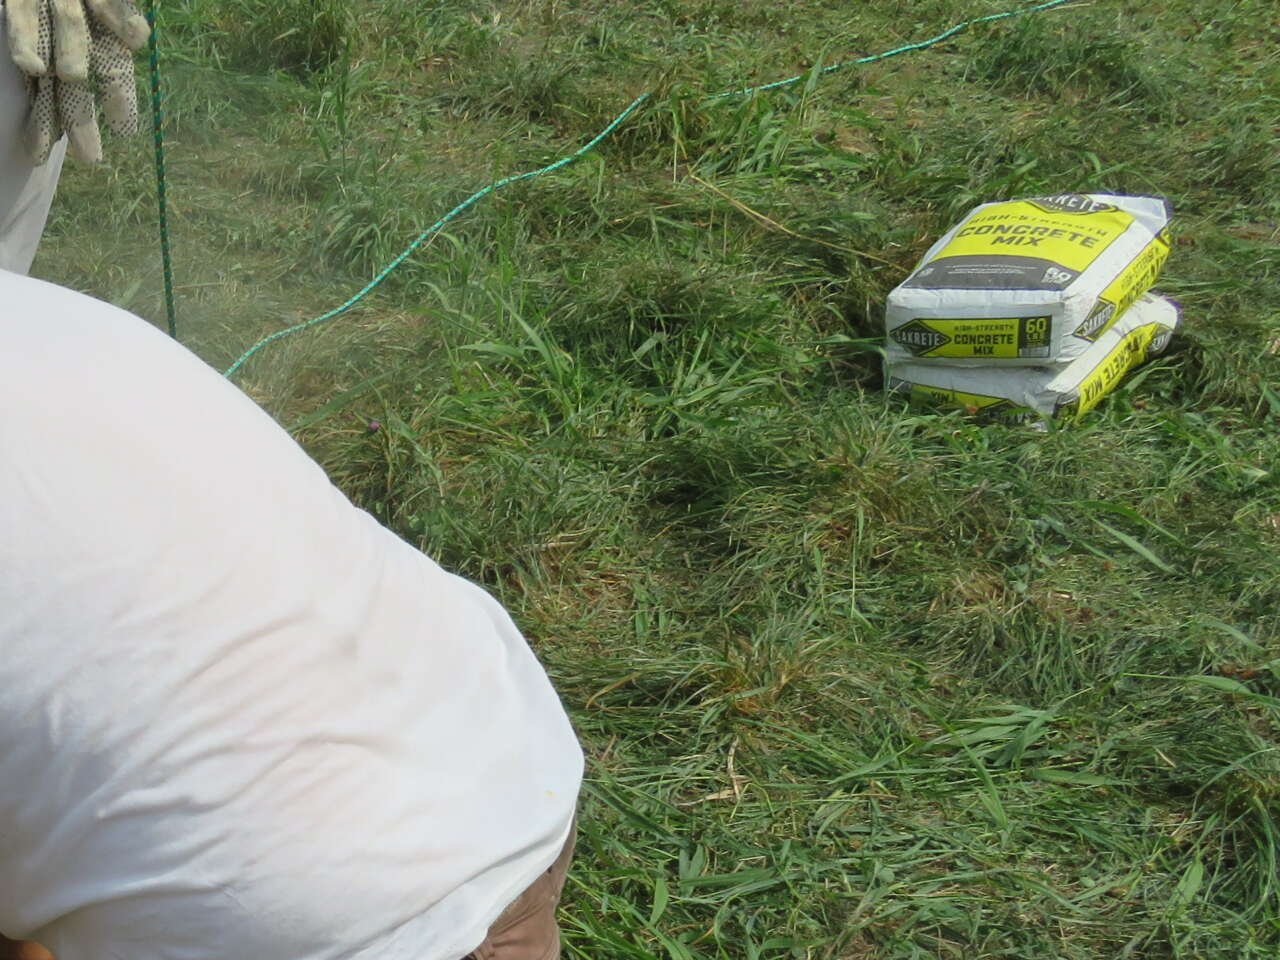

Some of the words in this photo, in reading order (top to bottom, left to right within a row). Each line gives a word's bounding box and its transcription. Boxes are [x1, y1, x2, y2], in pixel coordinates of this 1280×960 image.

[956, 224, 1100, 248] CONCRETE
[991, 236, 1044, 246] MIX
[1025, 318, 1046, 333] 60
[896, 331, 940, 346] SAKRETE
[954, 334, 1013, 344] CONCRETE
[974, 345, 994, 354] MIX
[1083, 375, 1103, 402] MIX
